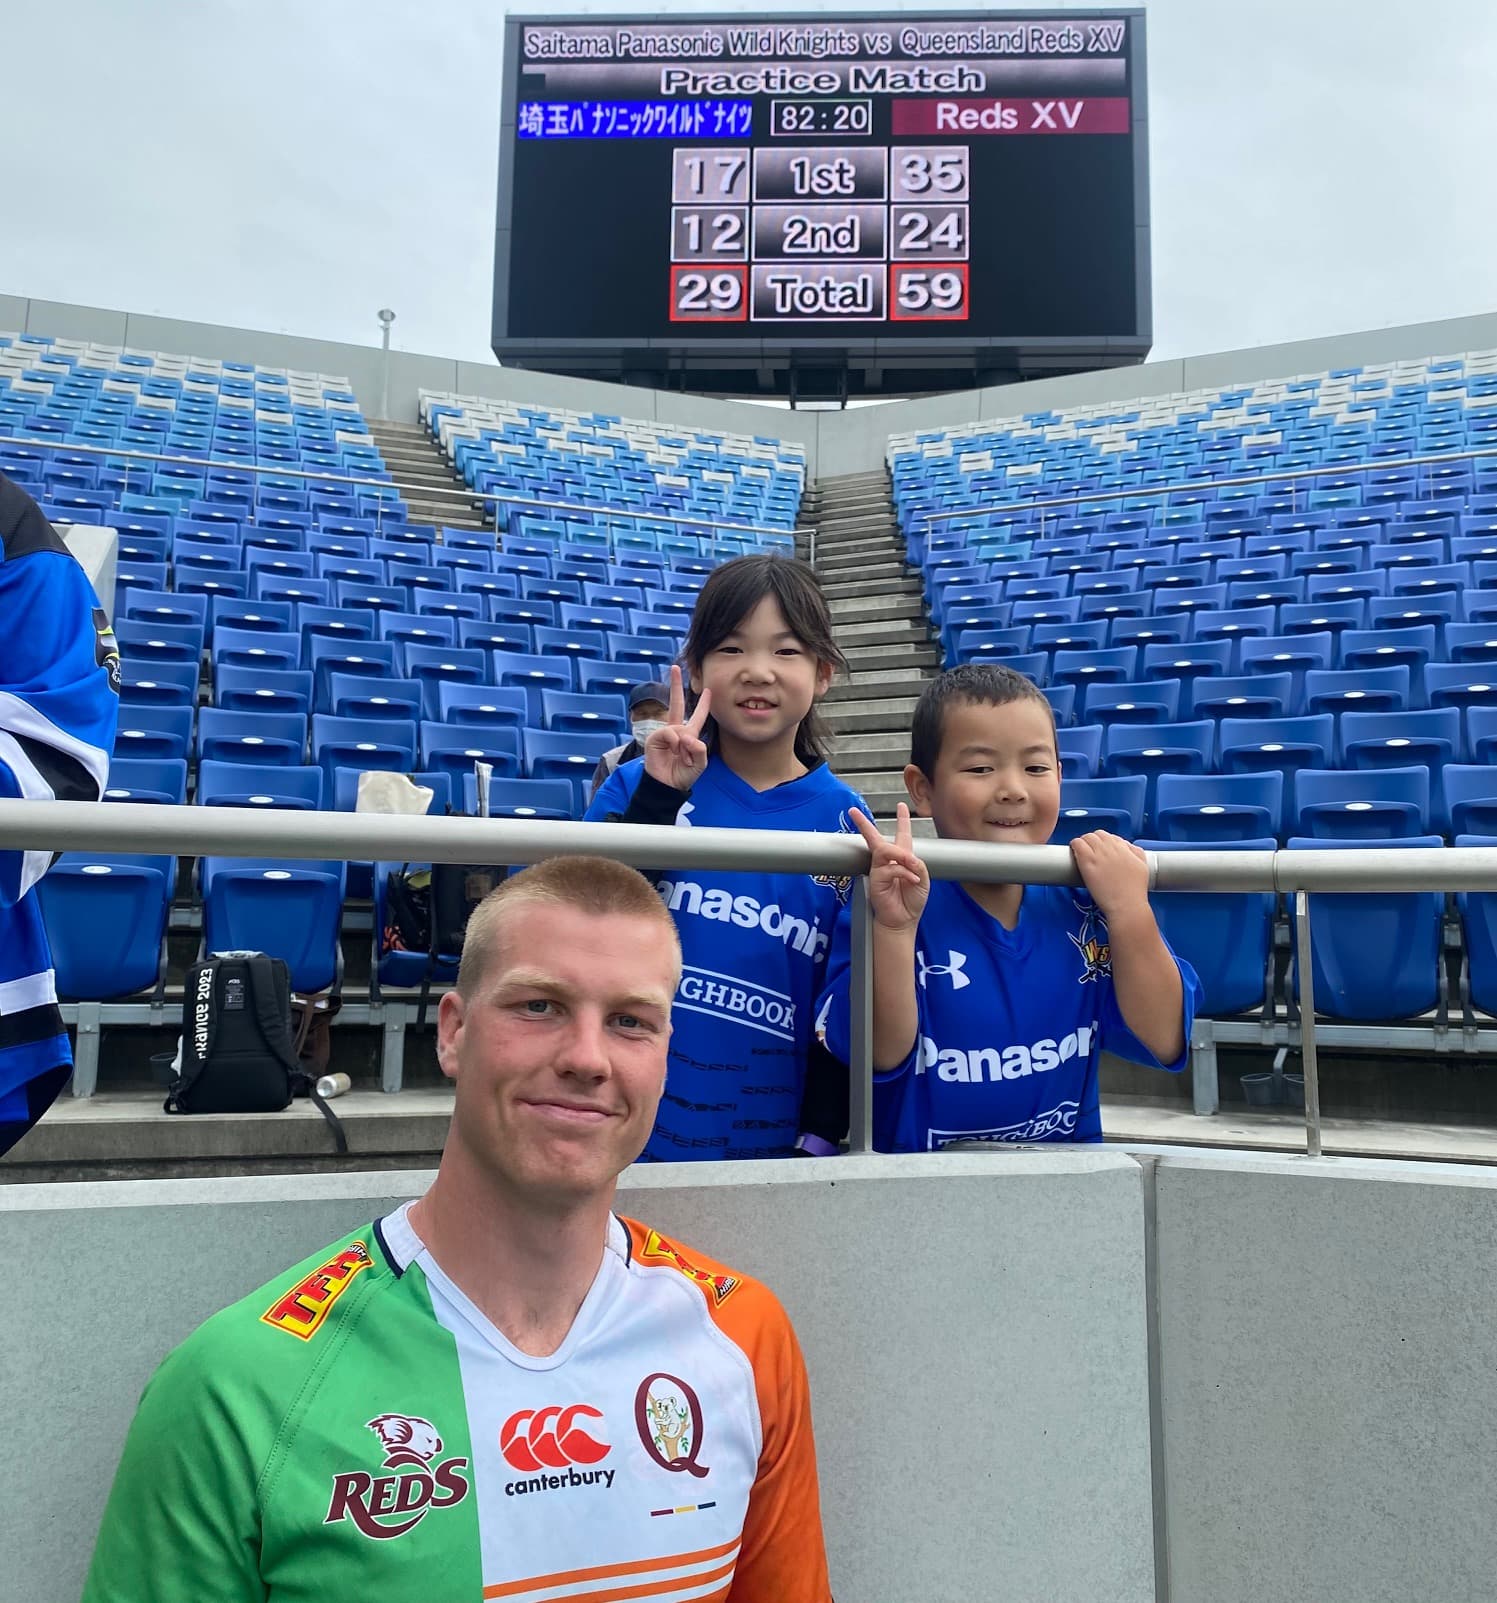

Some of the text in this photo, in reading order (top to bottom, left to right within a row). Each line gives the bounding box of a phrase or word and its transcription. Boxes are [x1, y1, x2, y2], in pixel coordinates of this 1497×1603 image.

[525, 25, 1125, 58] Saitama Panasonic Wild Knights vs Queensland Reds XV
[661, 67, 985, 94] Practice Match
[781, 105, 868, 130] 82:20
[936, 101, 1084, 130] Reds XV
[684, 154, 965, 194] 17 1st 35
[682, 212, 964, 253] 12 2nd 24
[678, 272, 963, 313] 29 Total 59
[656, 880, 829, 963] anasonic
[196, 967, 213, 1001] 2023
[679, 976, 797, 1030] GHBOOK
[323, 1457, 469, 1540] REDS
[504, 1467, 616, 1497] canterbury
